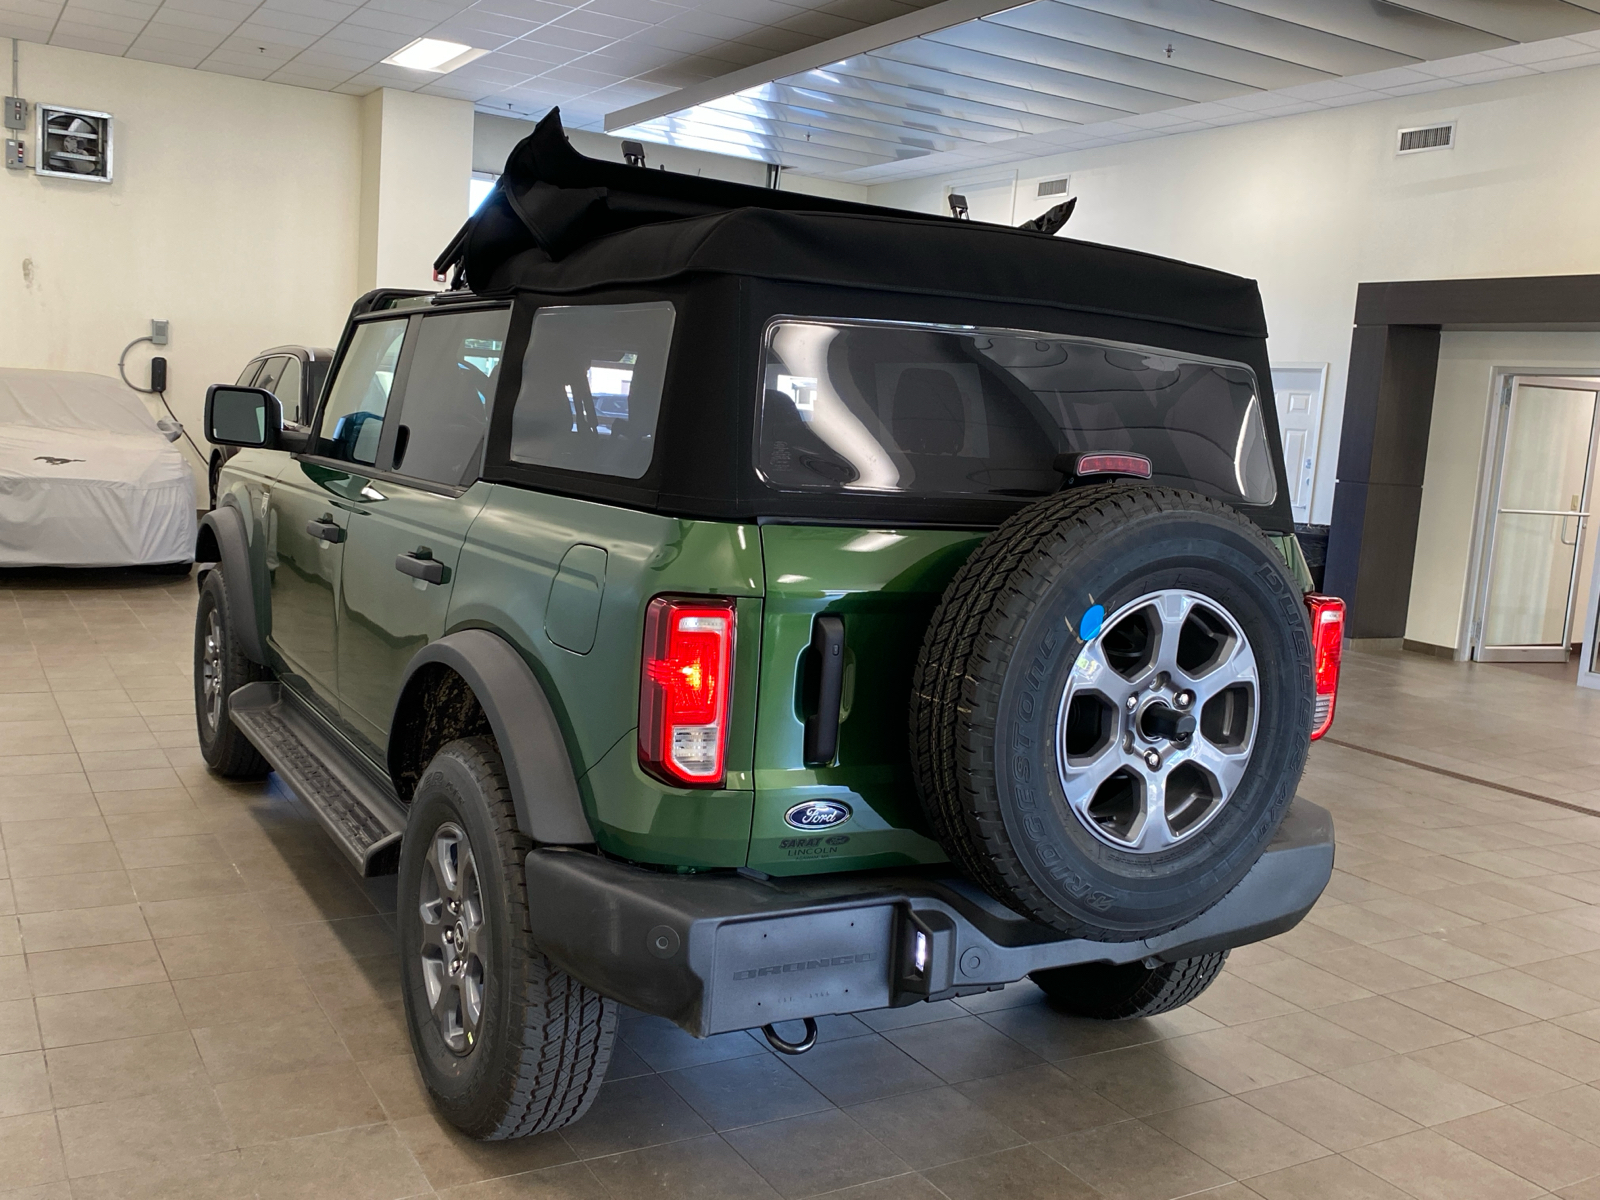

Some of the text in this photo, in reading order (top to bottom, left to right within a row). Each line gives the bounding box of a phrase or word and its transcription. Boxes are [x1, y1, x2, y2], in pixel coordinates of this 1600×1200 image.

[1256, 562, 1312, 773] DUELER
[1010, 628, 1118, 913] BRIDGESTONE
[802, 806, 836, 823] Ford
[780, 837, 824, 849] SARAT
[788, 847, 838, 857] LINCOLN
[733, 953, 876, 981] BRONCO
